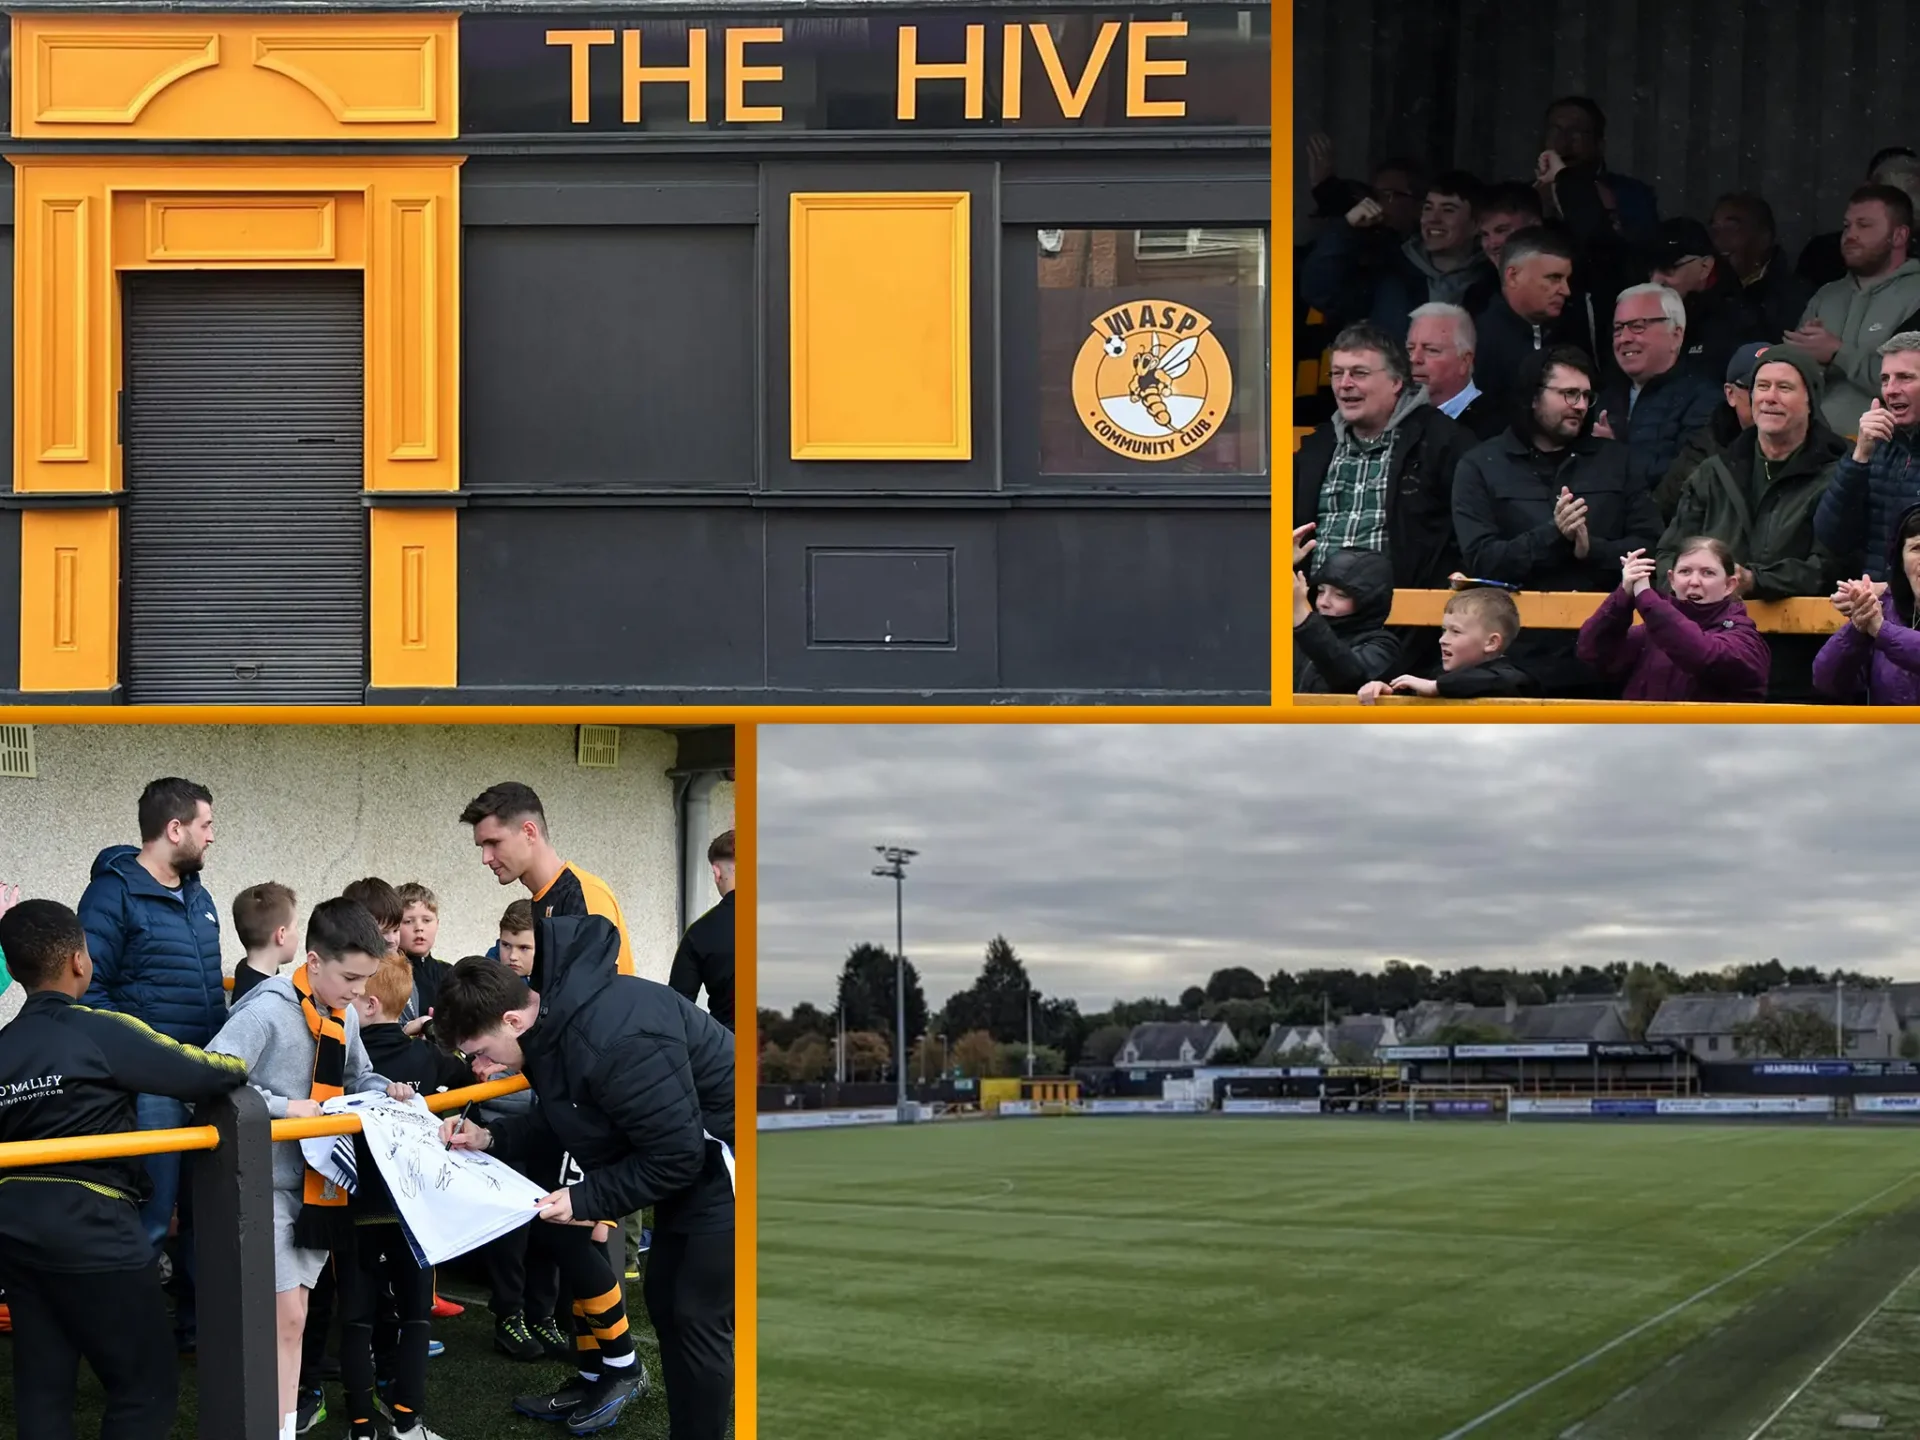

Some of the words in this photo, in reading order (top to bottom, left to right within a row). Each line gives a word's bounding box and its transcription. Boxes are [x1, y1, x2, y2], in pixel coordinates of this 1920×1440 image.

[545, 26, 784, 124] THE
[895, 20, 1189, 121] HIVE
[1103, 304, 1198, 335] WASP
[1093, 419, 1176, 455] COMMUNITY
[1180, 418, 1213, 447] CLUB
